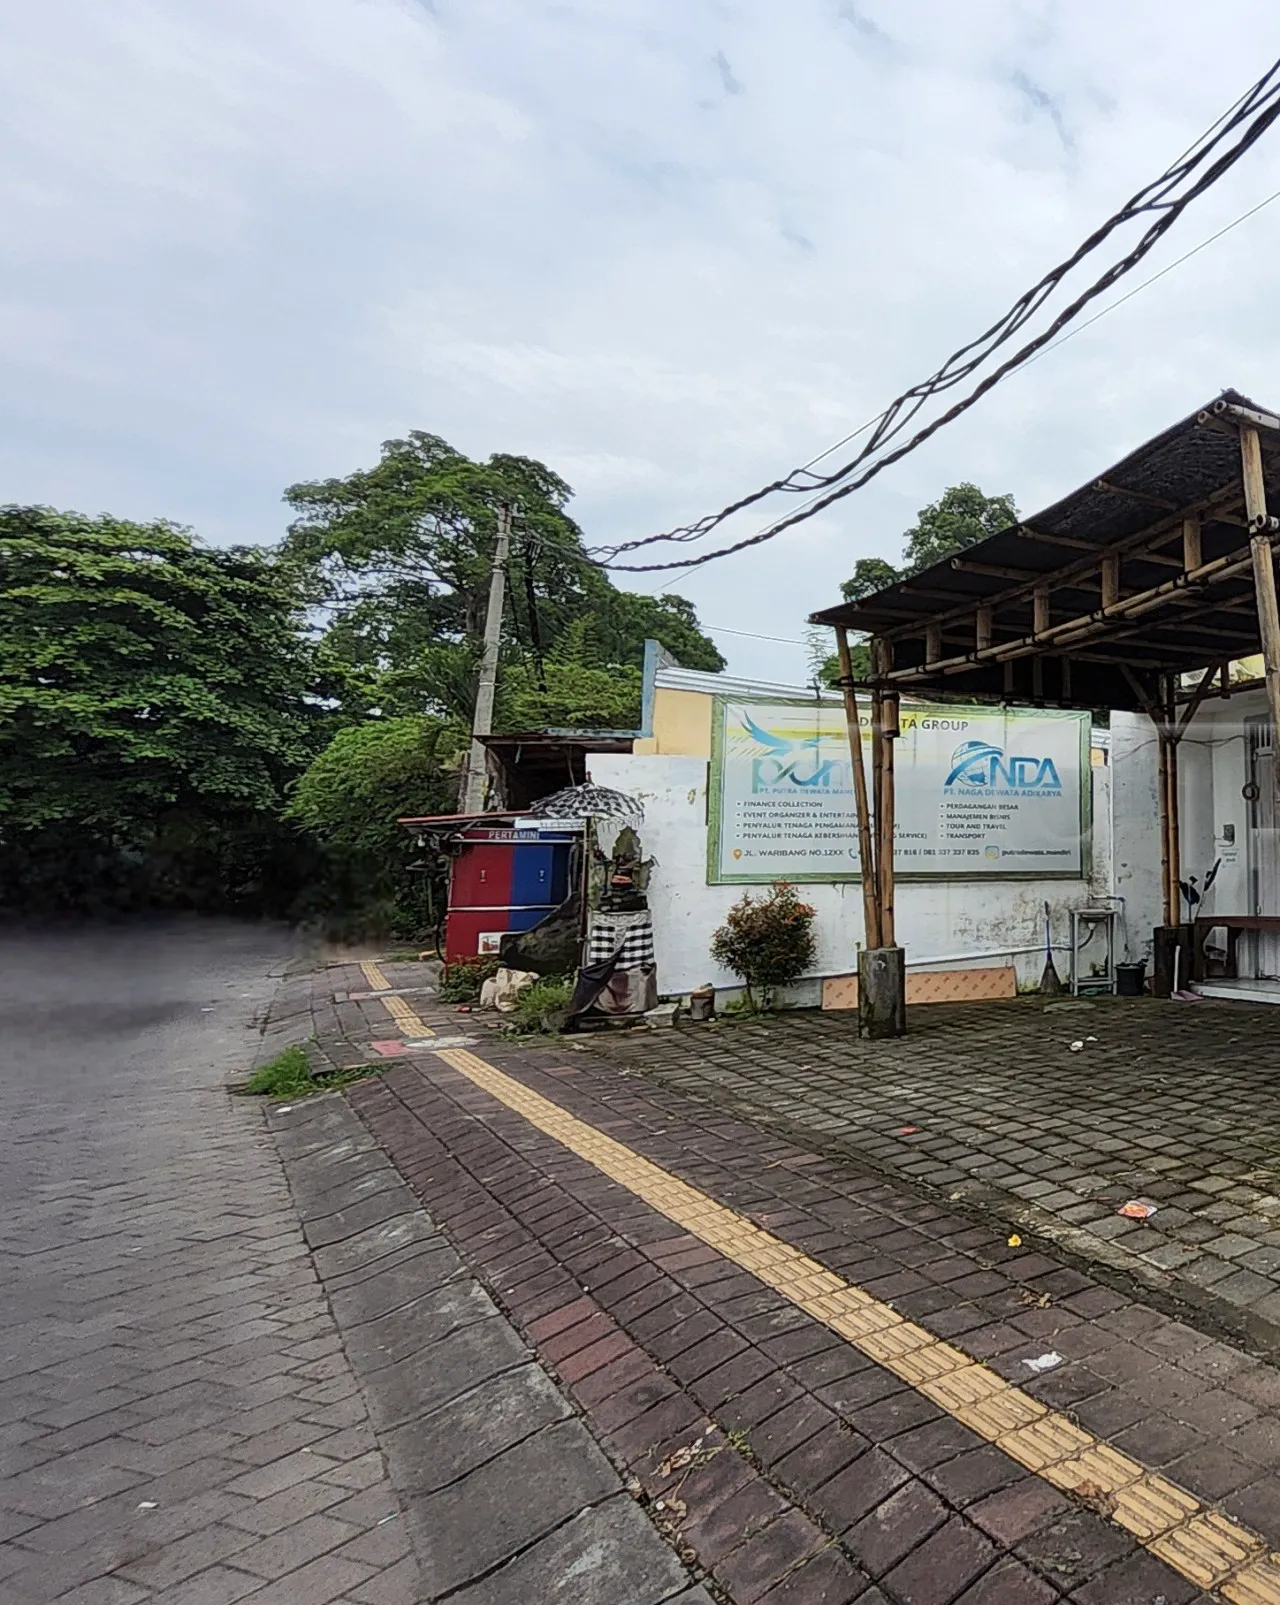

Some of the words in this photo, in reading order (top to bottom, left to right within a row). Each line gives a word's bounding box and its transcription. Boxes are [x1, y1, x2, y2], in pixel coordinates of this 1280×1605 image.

[921, 719, 969, 732] GROUP
[957, 788, 983, 797] NAGA
[743, 800, 777, 808] FINANCE
[777, 800, 823, 808] COLLECTION
[743, 811, 767, 819] EVENT
[768, 811, 811, 819] ORGANIZER
[946, 813, 988, 821] MANAJEMEN
[743, 821, 782, 830] PENYALUR
[783, 821, 814, 830] TENAGA
[966, 823, 982, 831] AND
[743, 832, 782, 840] PENYALUR
[946, 832, 986, 840] TRANSPORT
[759, 849, 807, 857] WARIBANG
